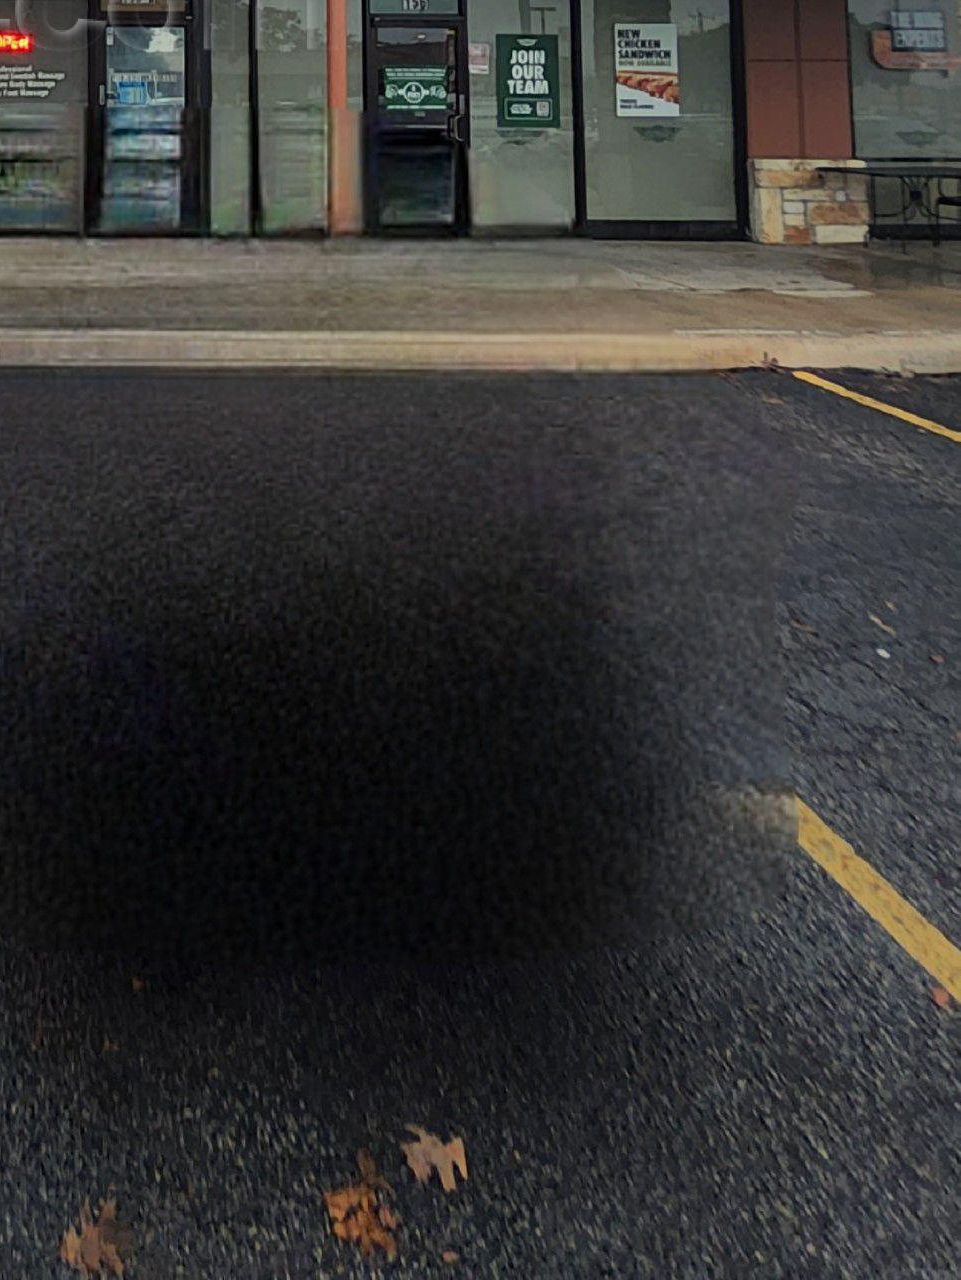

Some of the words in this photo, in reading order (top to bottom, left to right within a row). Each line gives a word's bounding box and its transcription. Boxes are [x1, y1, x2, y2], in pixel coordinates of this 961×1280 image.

[617, 29, 640, 39] NEW
[617, 39, 661, 49] CHICKEN
[509, 49, 546, 65] JOIN
[617, 49, 672, 59] SANDWICH
[511, 64, 545, 80] OUR
[506, 79, 550, 95] TEAM
